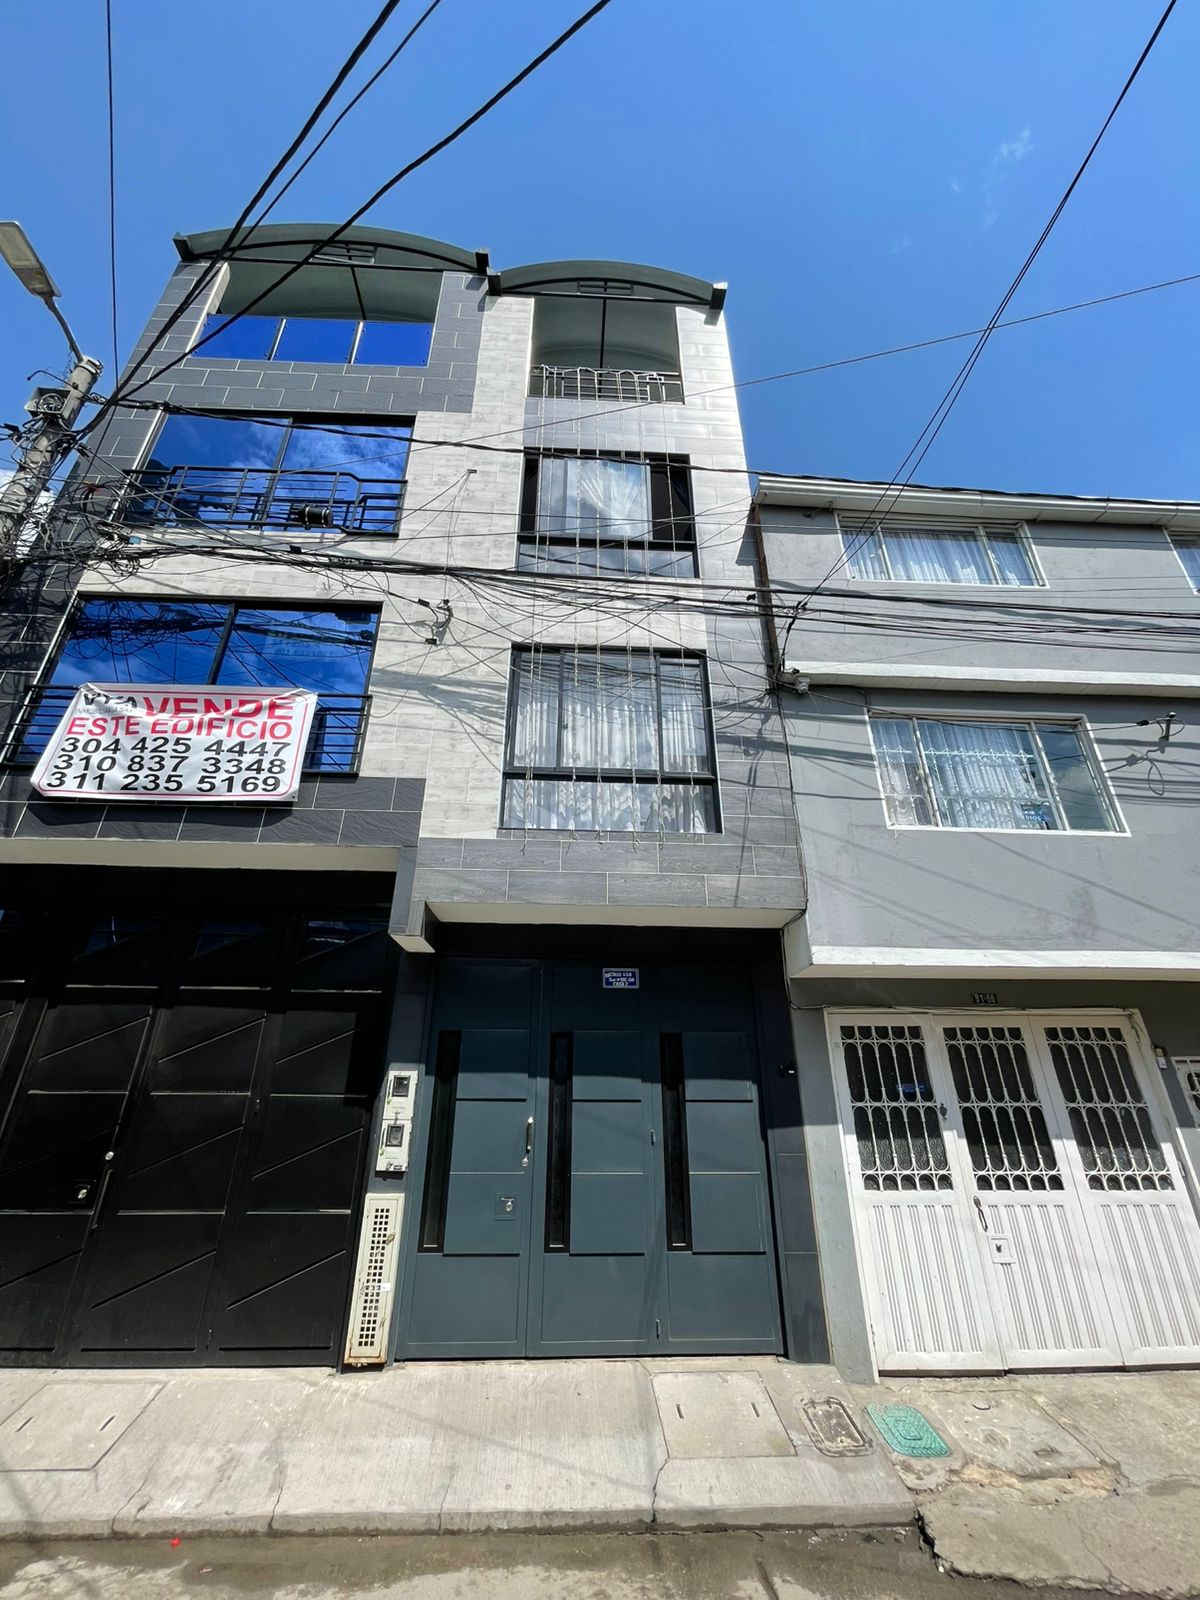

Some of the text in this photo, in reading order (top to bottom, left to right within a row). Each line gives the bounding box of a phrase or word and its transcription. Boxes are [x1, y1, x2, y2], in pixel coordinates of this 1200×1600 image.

[143, 696, 293, 720] VENDE
[66, 715, 293, 739] ESTE EDIFICIO
[60, 737, 291, 757] 304 425 4447
[53, 754, 286, 775] 310 837 3348
[46, 771, 281, 793] 311 235 5169
